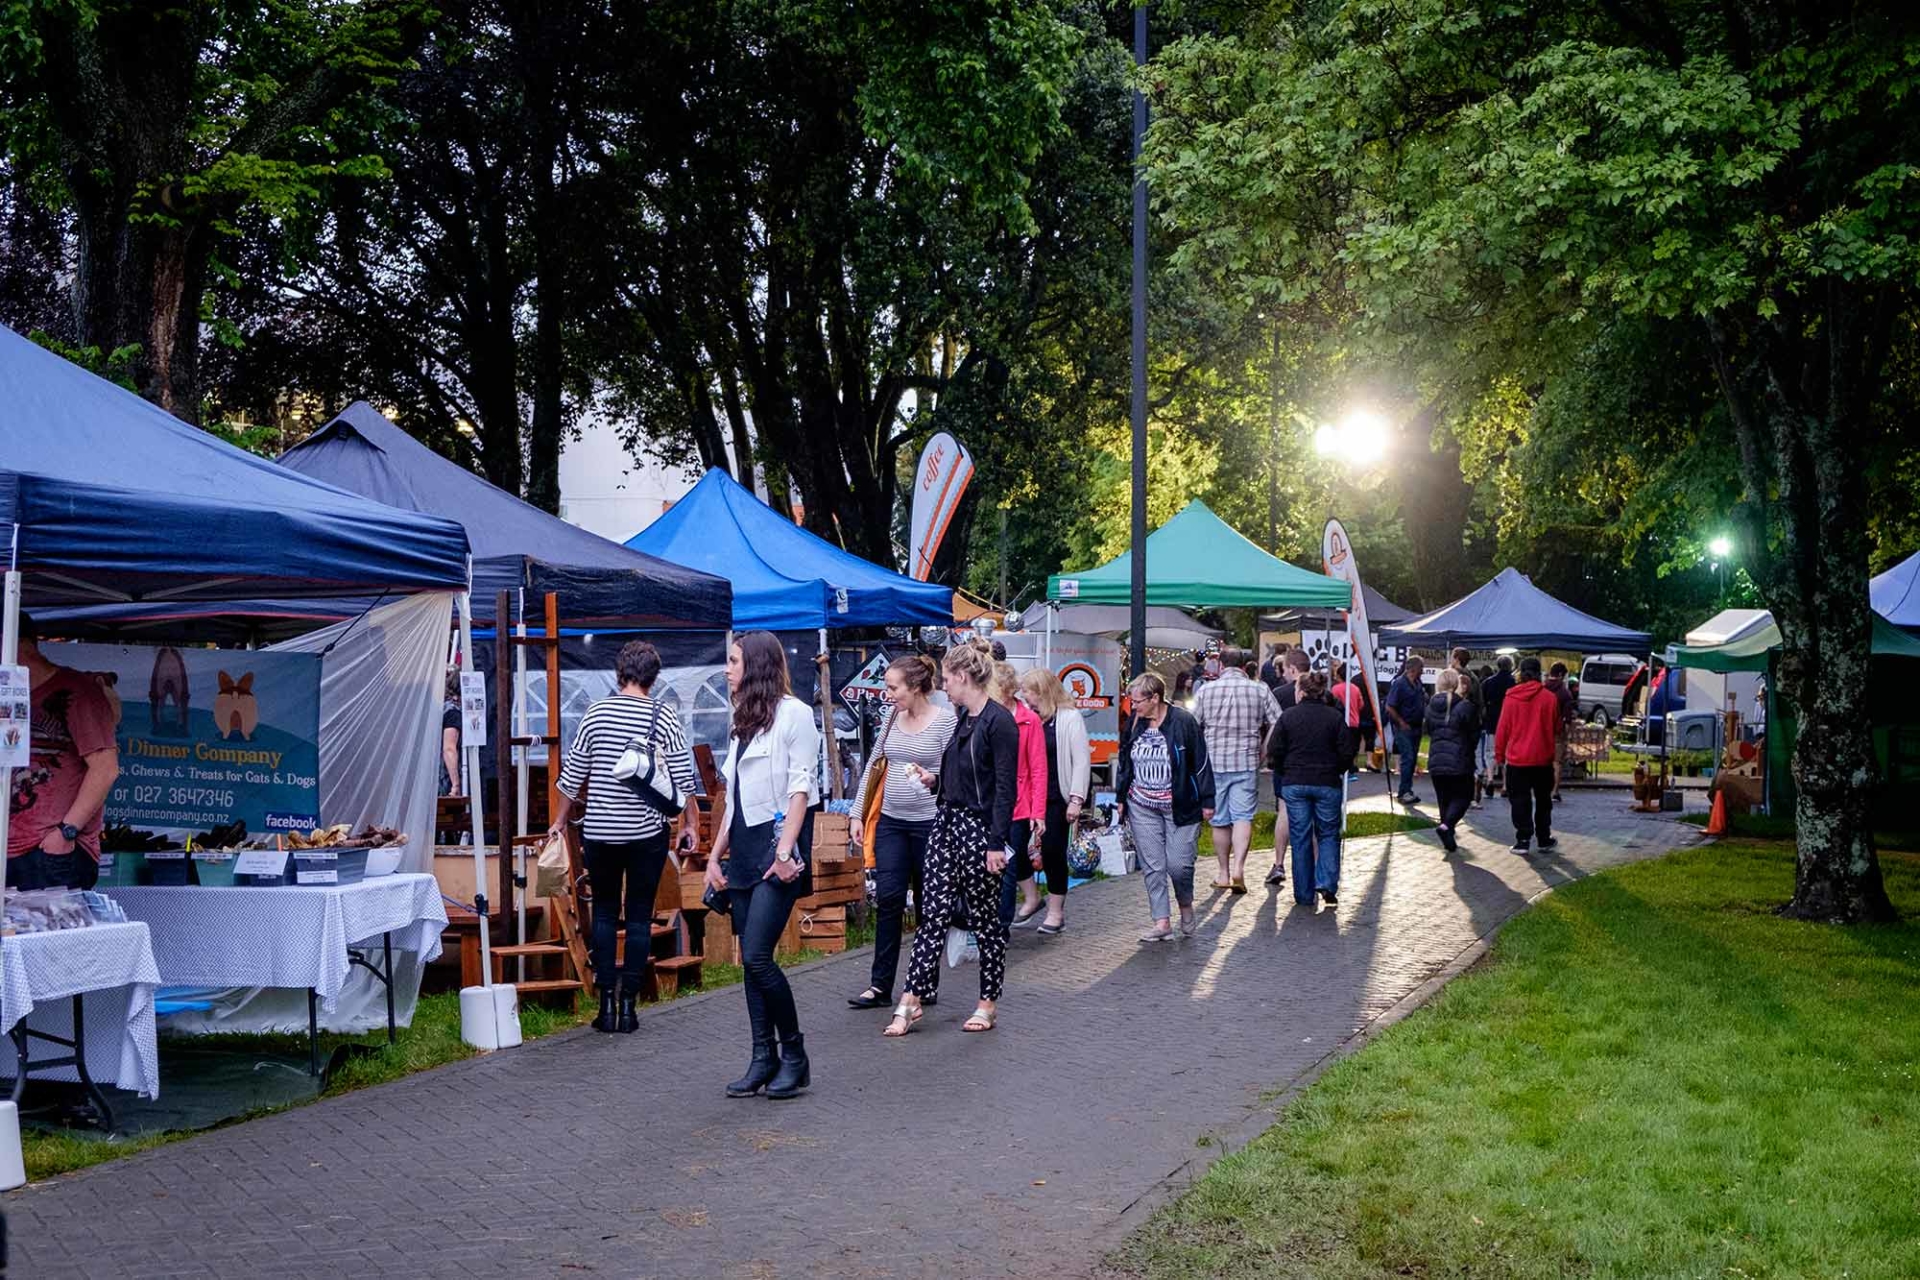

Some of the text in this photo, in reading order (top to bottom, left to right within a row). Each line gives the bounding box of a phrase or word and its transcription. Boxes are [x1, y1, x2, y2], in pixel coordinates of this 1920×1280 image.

[923, 443, 944, 492] coffee
[125, 737, 190, 759] Dinner
[195, 742, 283, 768] Company
[131, 764, 170, 777] Chews
[174, 766, 184, 778] &
[188, 767, 223, 780] Treats
[226, 770, 242, 782] for
[245, 771, 270, 784] Cats
[273, 773, 283, 785] &
[287, 773, 316, 788] Dogs
[114, 785, 234, 808] or 027 3647346
[265, 814, 316, 829] facebook
